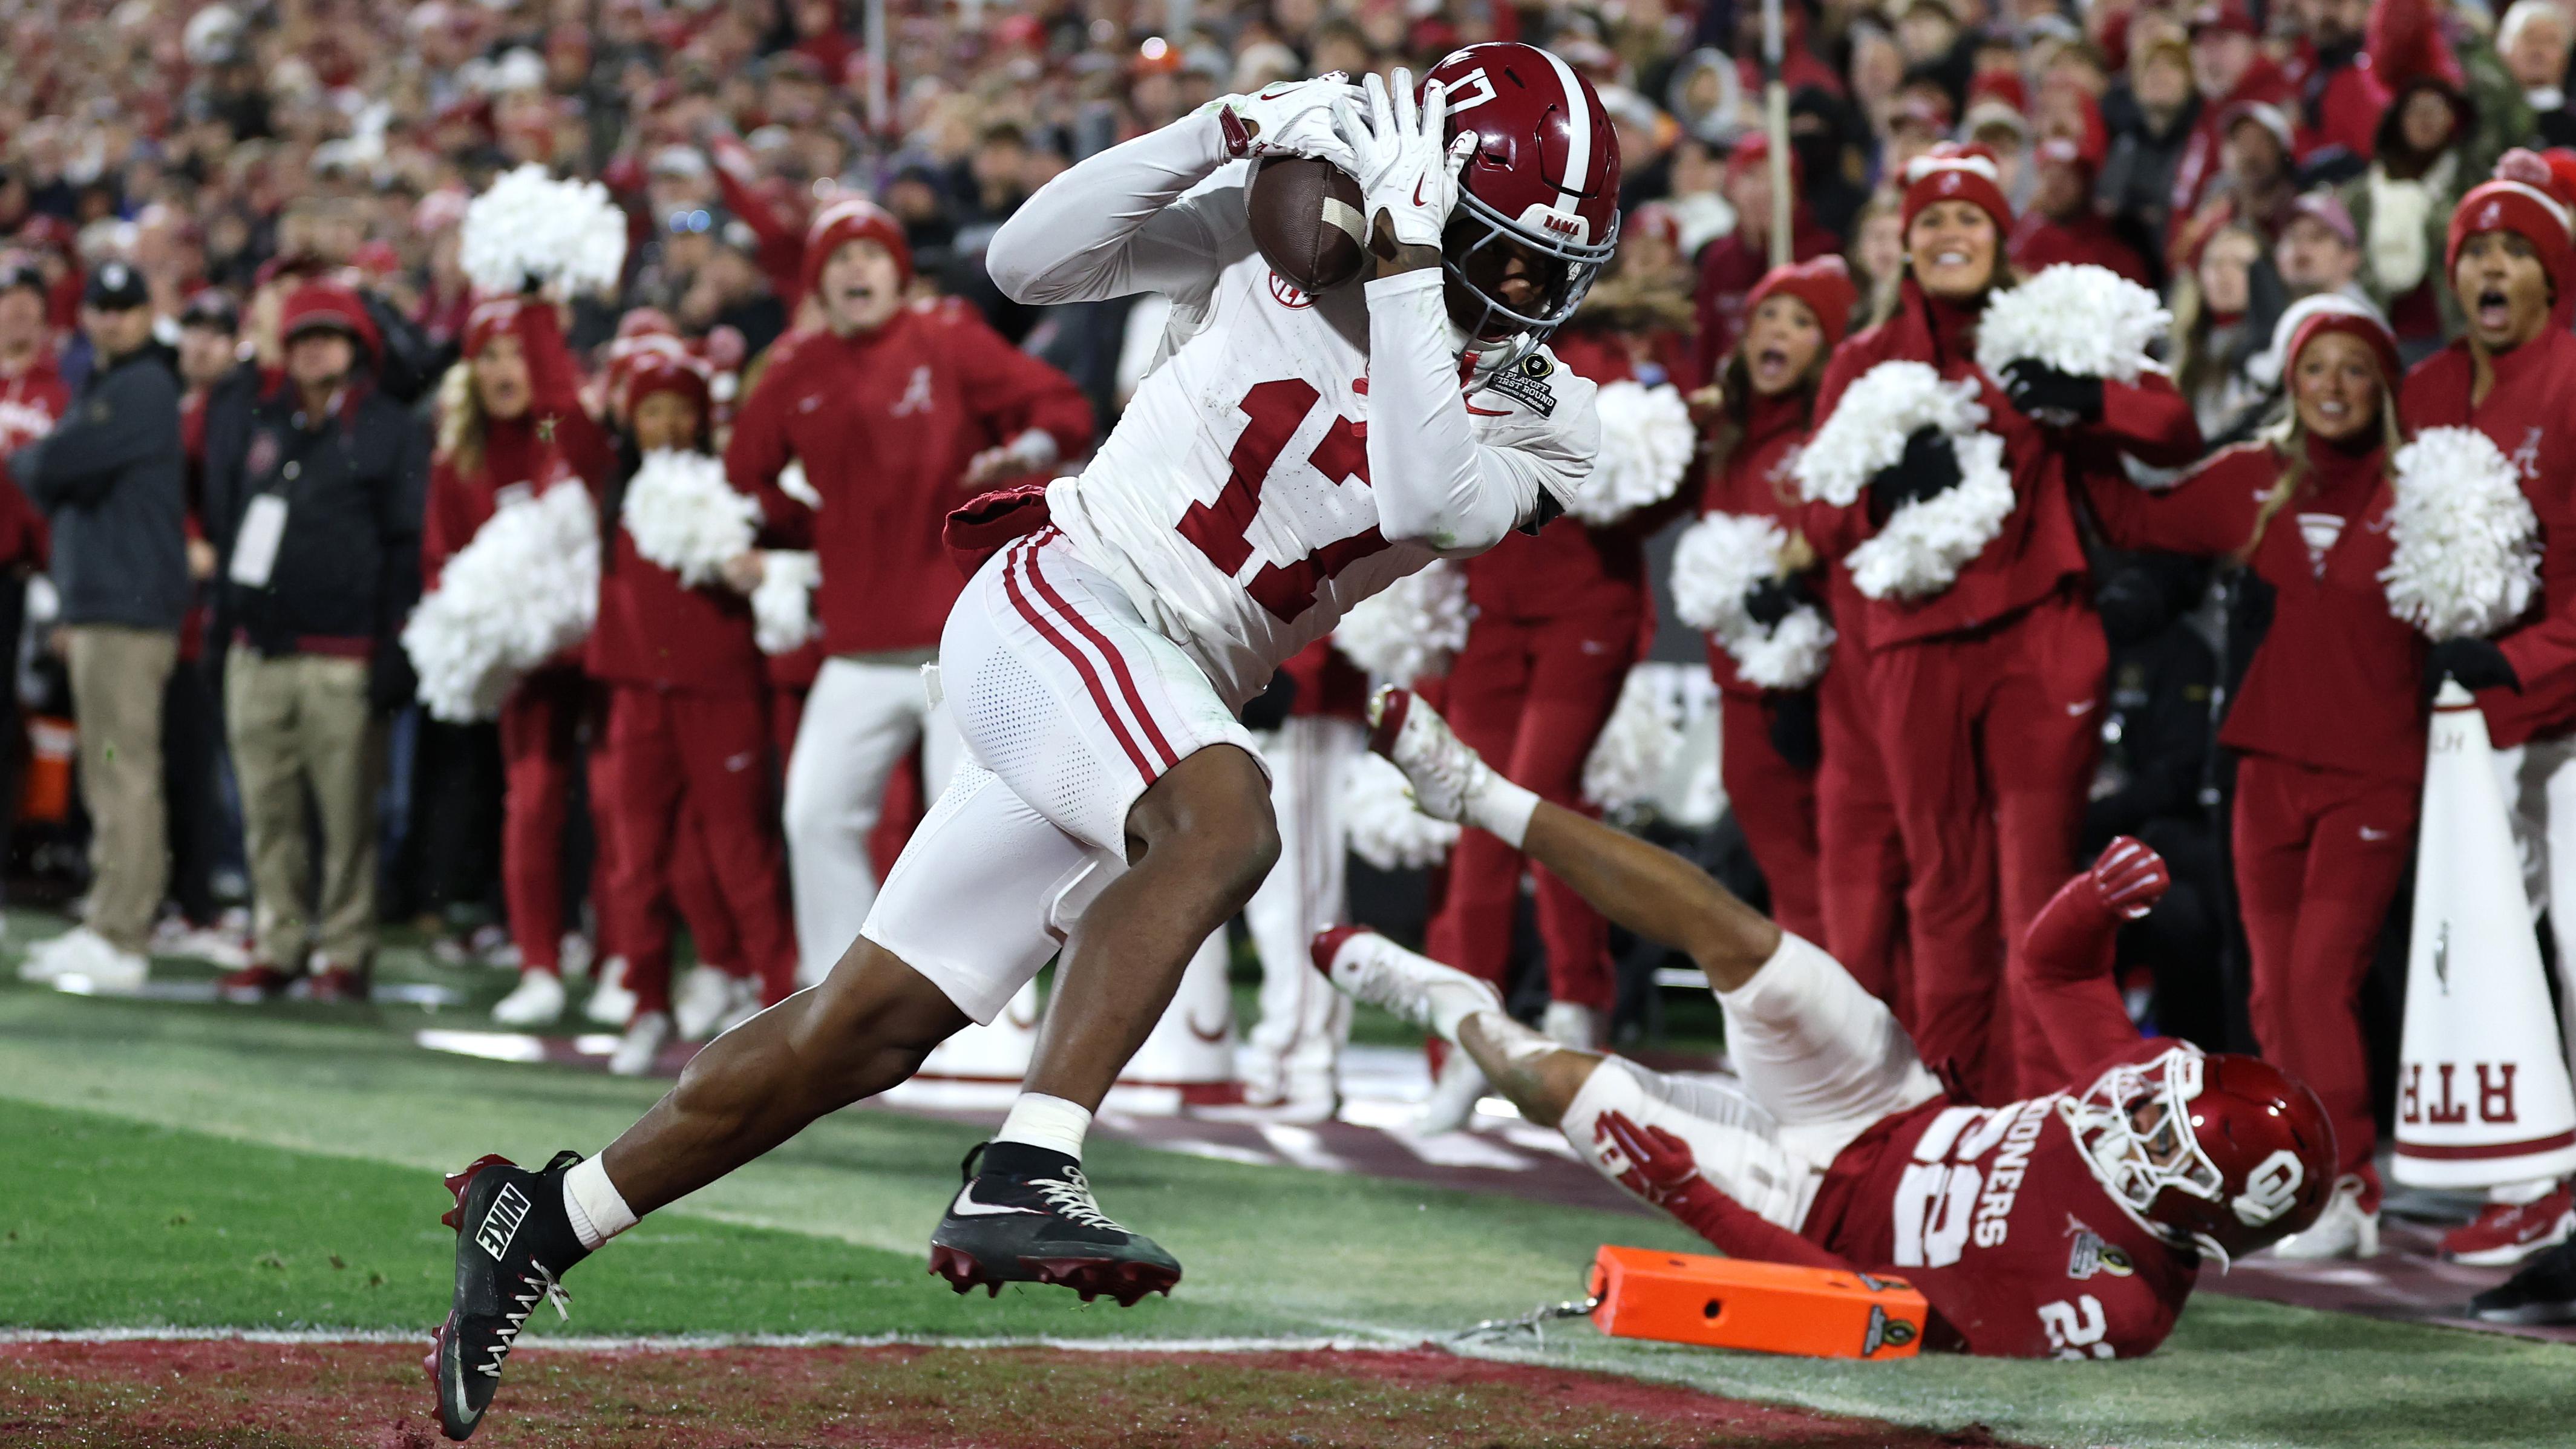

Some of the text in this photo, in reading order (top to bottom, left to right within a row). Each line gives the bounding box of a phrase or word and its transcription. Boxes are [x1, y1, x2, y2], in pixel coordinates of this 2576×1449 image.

[1445, 67, 1497, 117] 17
[1543, 214, 1580, 235] BAMA
[1493, 376, 1554, 407] FIRST ROUND
[1495, 384, 1520, 396] PRESENTED
[1525, 396, 1545, 411] Allstate
[1505, 371, 1549, 393] PLAYOFF
[1974, 1093, 2053, 1248] OONERS
[477, 1185, 529, 1258] NIKE
[2036, 1294, 2116, 1361] 2
